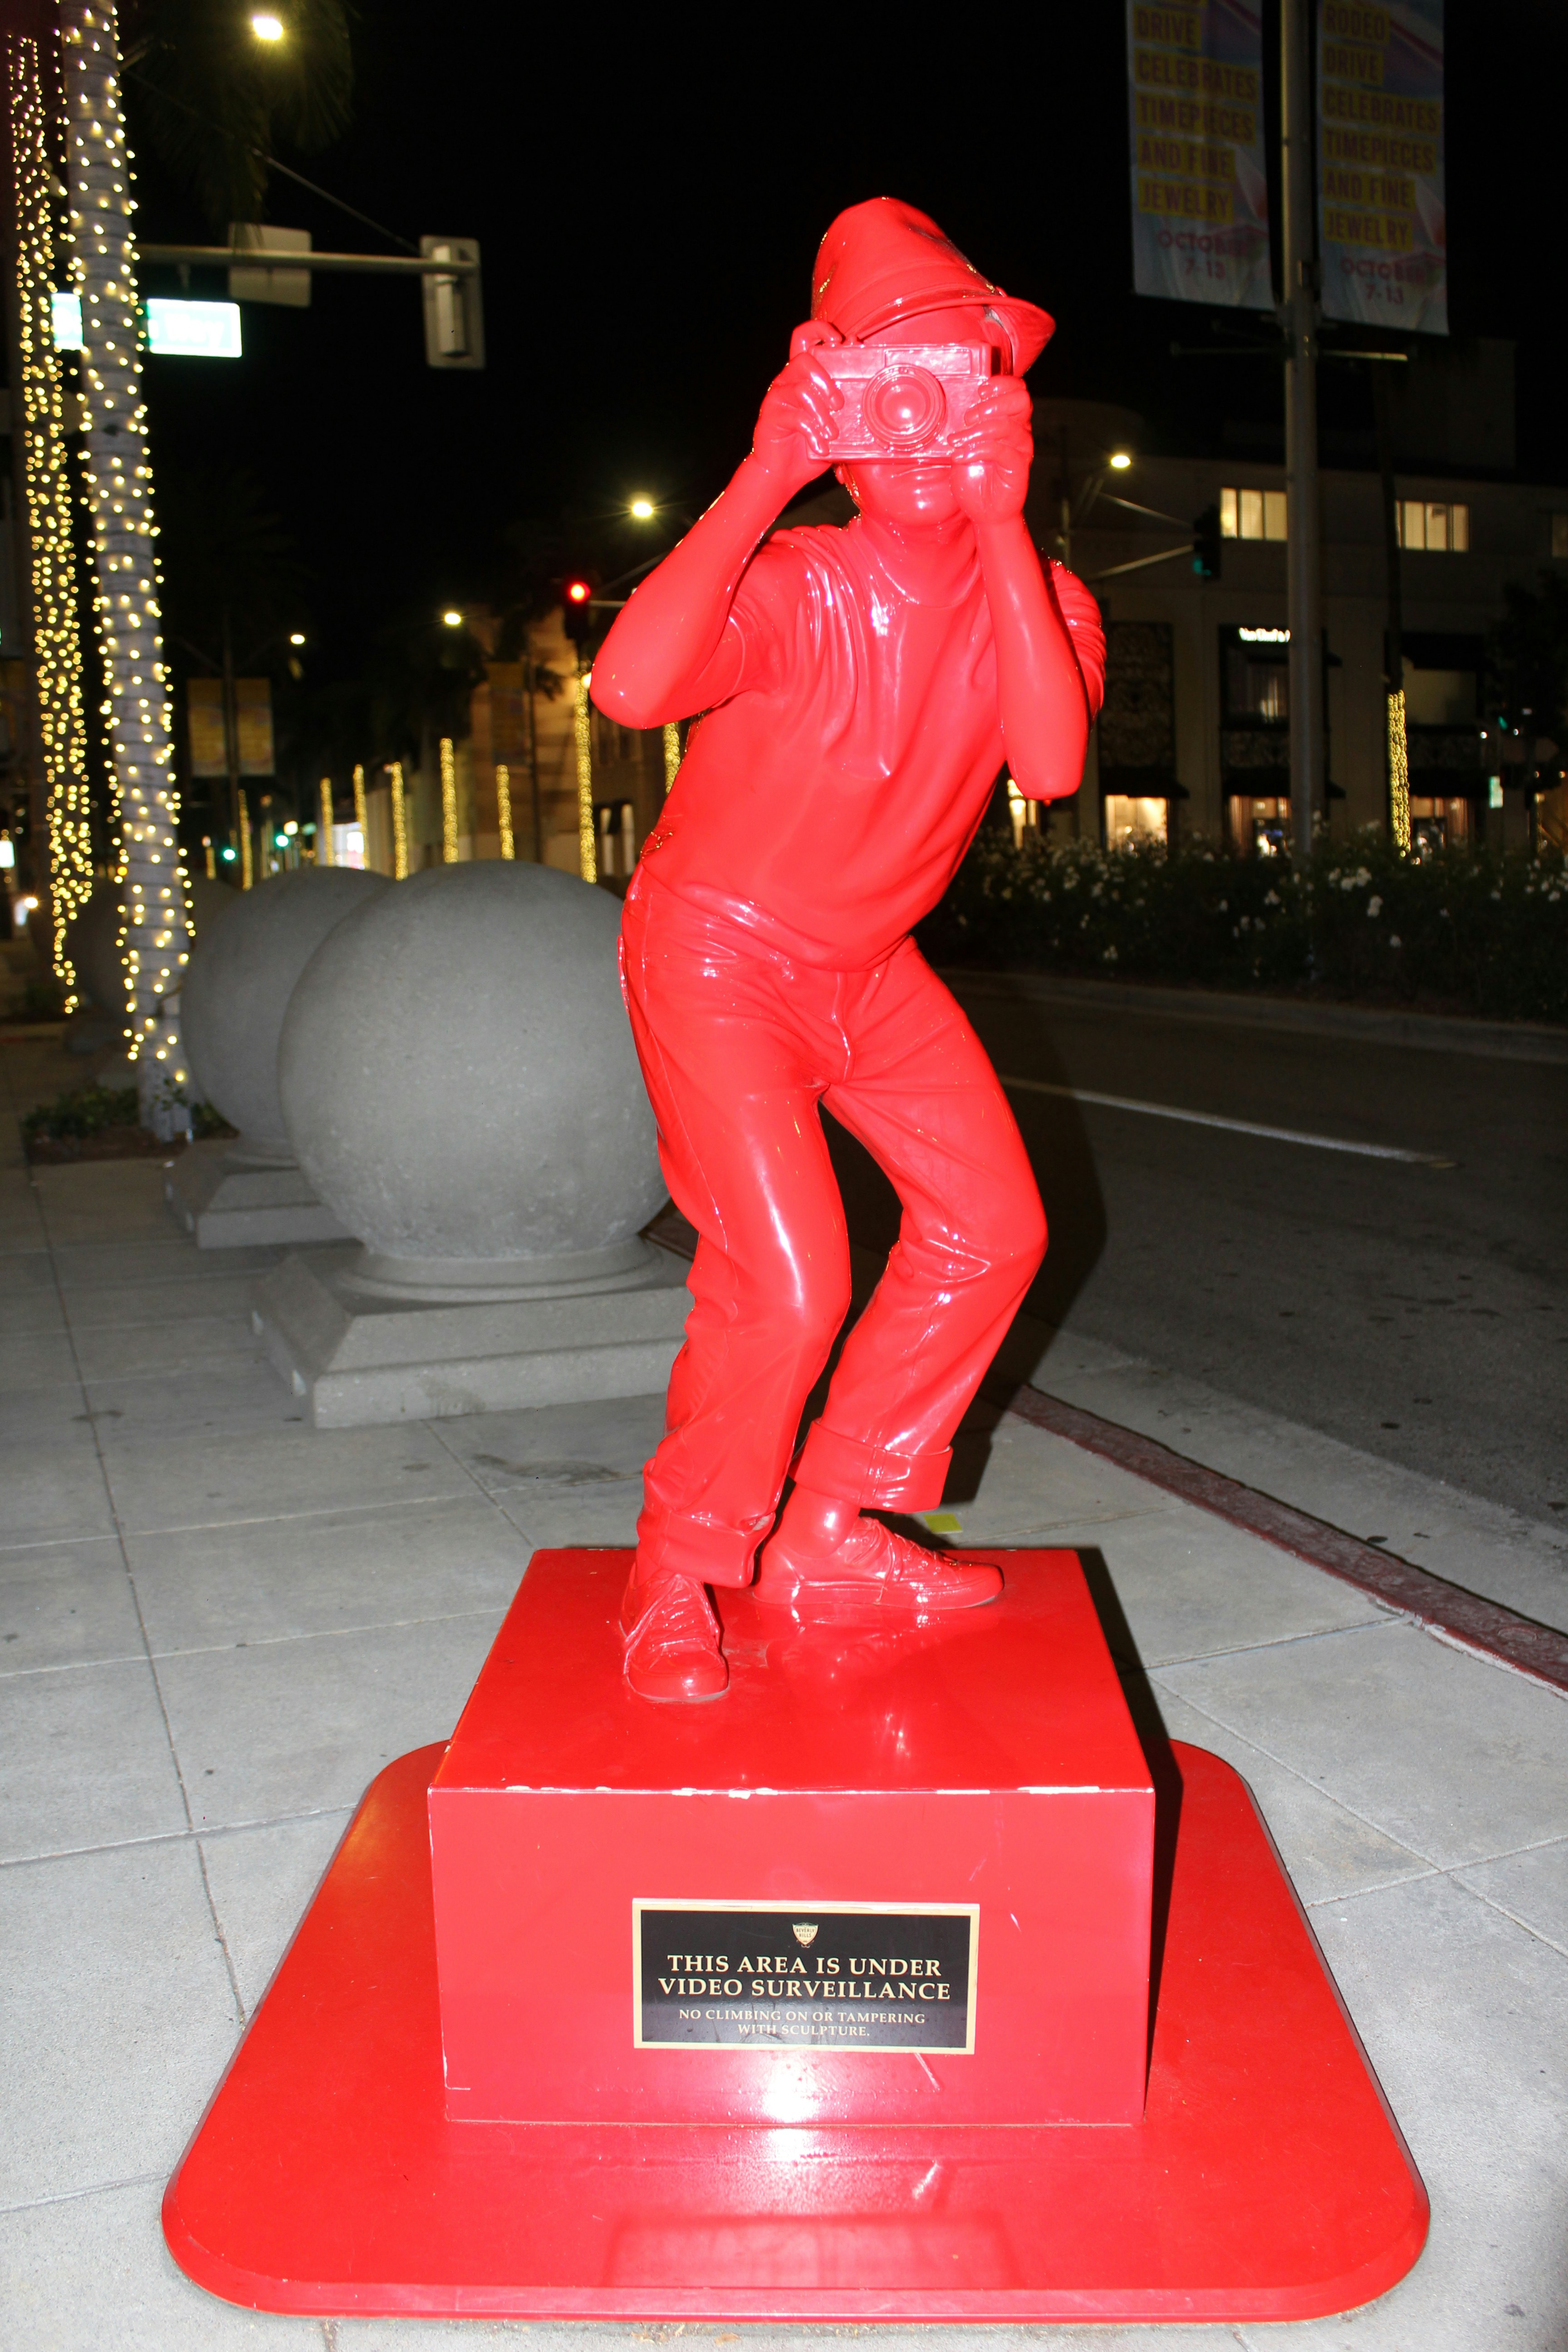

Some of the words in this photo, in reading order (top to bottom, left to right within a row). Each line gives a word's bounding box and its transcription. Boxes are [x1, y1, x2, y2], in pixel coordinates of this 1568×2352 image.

[1138, 9, 1195, 44] DRIVE
[1326, 4, 1385, 41] RODEO
[1139, 53, 1256, 99] CELEBRATES
[1326, 47, 1378, 82] DRIVE
[1141, 94, 1254, 141] TIMEPIECES
[1325, 87, 1436, 132] CELEBRATES
[1142, 139, 1181, 168] AND
[1189, 145, 1230, 178] FINE
[1326, 130, 1434, 170] TIMEPIECES
[1143, 182, 1231, 218] JEWELRY
[1326, 171, 1362, 200] AND
[1370, 177, 1410, 207] FINE
[1328, 212, 1408, 247] JEWELRY
[667, 1955, 730, 1973] THIS
[737, 1956, 808, 1974] AREA
[816, 1957, 840, 1975] IS
[849, 1958, 942, 1976] UNDER
[658, 1978, 743, 1996] VIDEO
[751, 1979, 951, 2000] SURVEILLANCE
[679, 2009, 701, 2019] NO
[706, 2010, 781, 2021] CLIMBING
[786, 2011, 808, 2021] ON
[812, 2012, 833, 2022] OR
[838, 2012, 926, 2024] TAMPERING
[738, 2024, 777, 2035] WITH
[781, 2025, 870, 2037] SCULPTURE.
